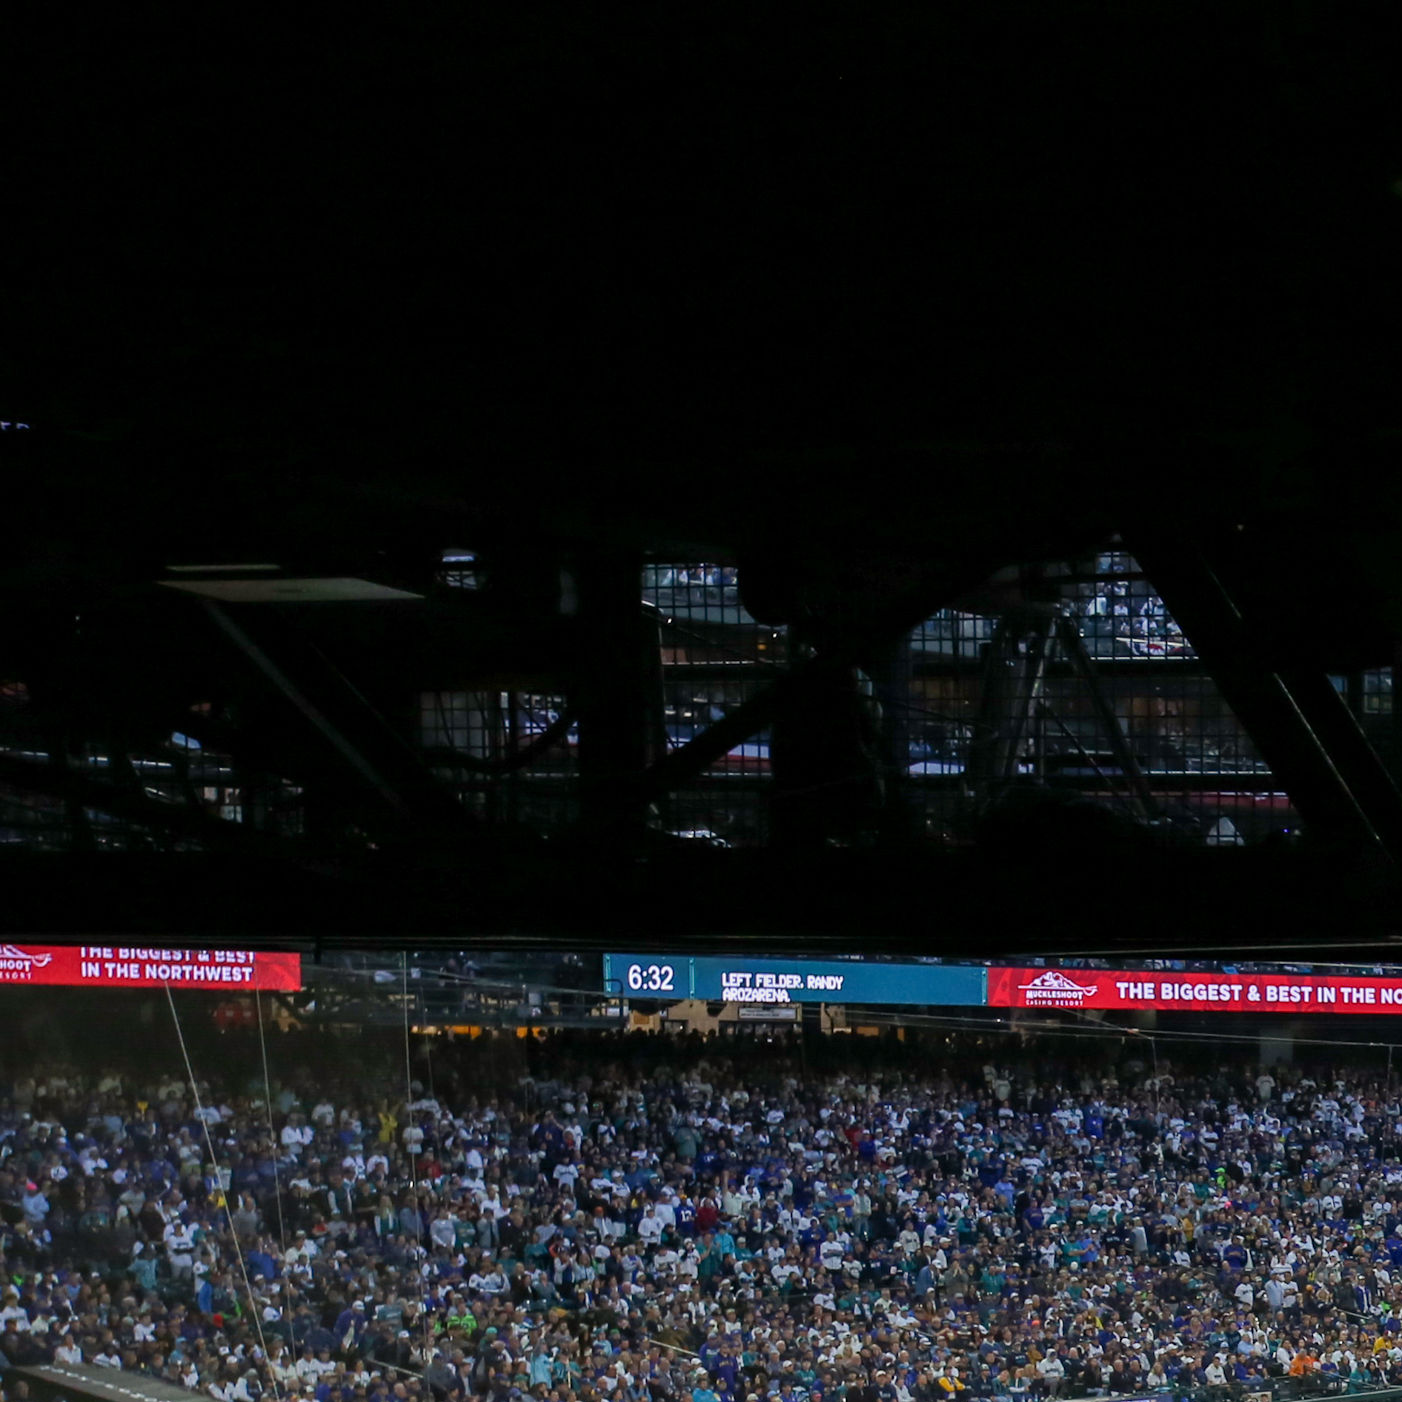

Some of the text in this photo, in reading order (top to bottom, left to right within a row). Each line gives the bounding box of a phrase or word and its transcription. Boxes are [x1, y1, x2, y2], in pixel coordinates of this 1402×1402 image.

[81, 962, 253, 983] IN THE NORTHWEST
[627, 964, 675, 992] 6:32
[721, 972, 752, 987] LEFT
[807, 975, 844, 990] RANDY
[722, 988, 791, 1003] AROZARENA.
[1026, 990, 1083, 1000] MUCKLESHOOT
[1116, 981, 1155, 1000] THE
[1160, 982, 1243, 1003] BIGGEST
[1248, 984, 1261, 1002] &
[1266, 985, 1312, 1003] BEST
[1316, 986, 1336, 1004] IN
[1339, 987, 1376, 1005] THE
